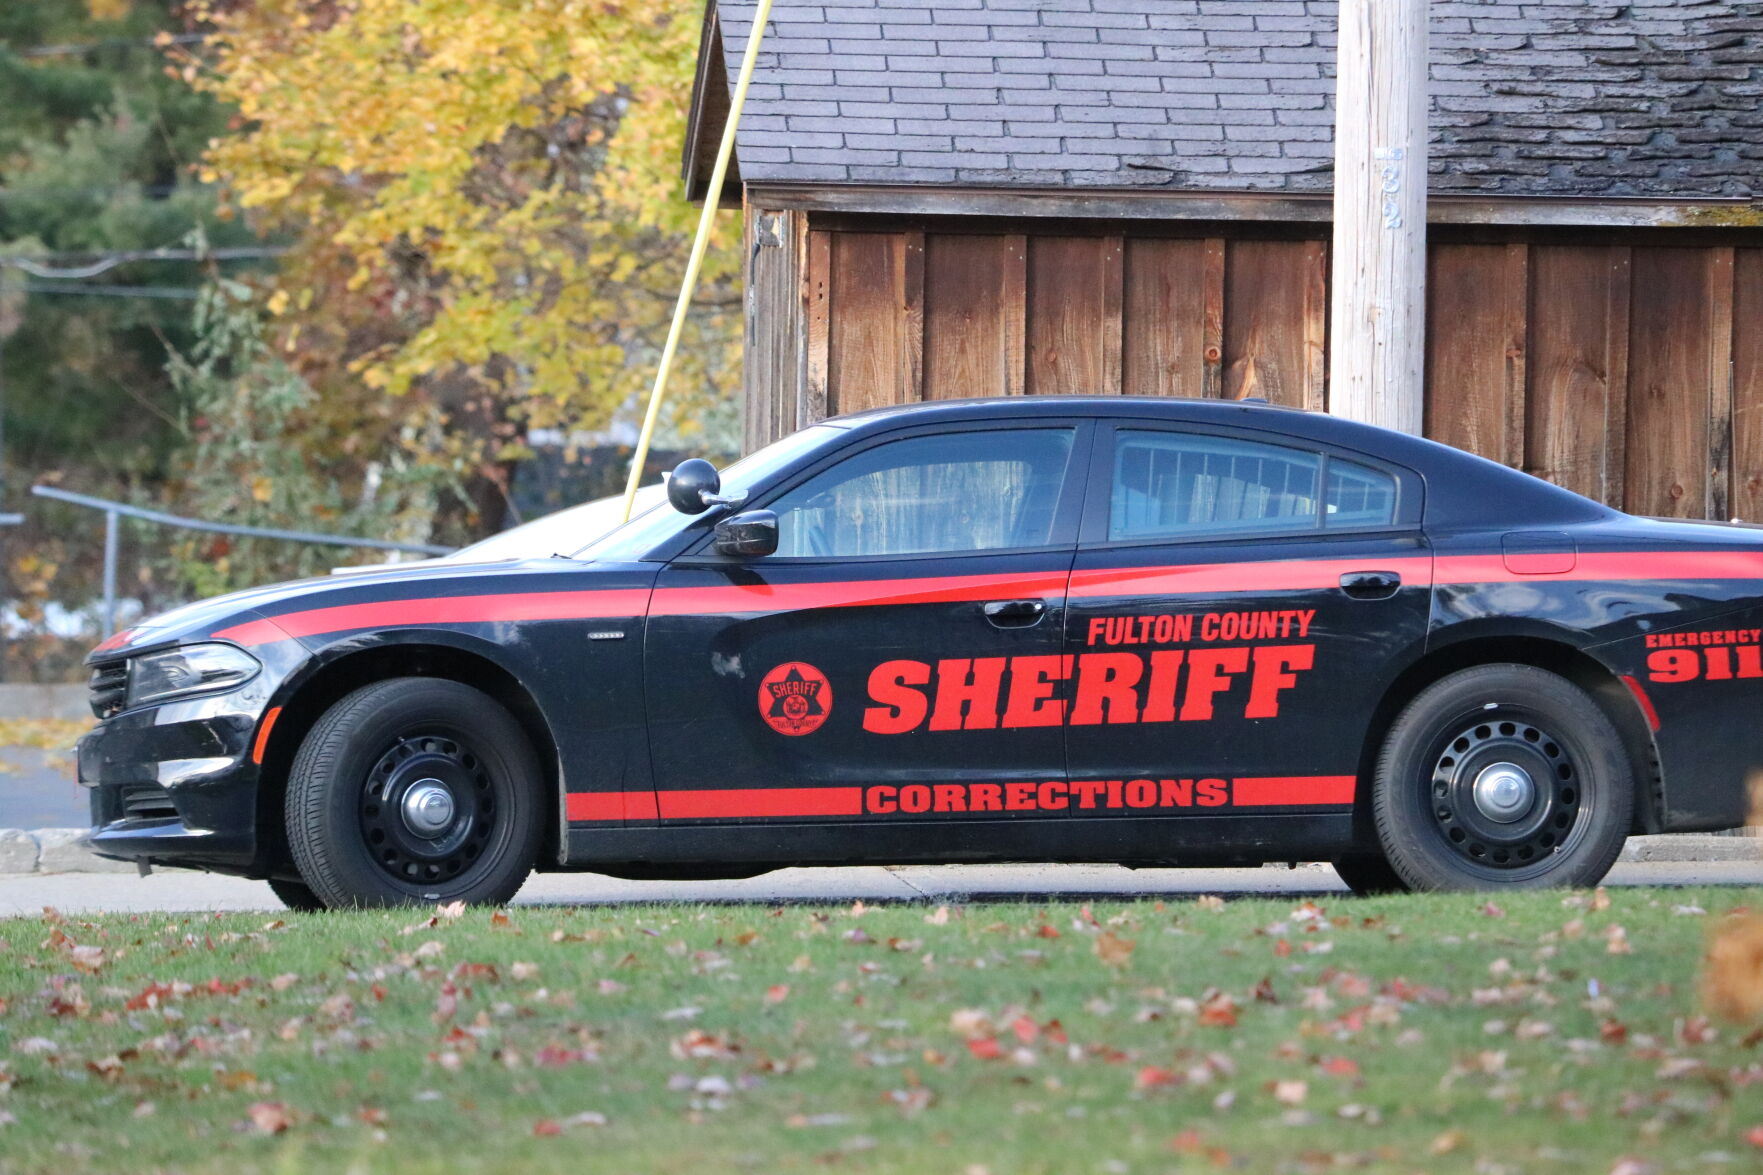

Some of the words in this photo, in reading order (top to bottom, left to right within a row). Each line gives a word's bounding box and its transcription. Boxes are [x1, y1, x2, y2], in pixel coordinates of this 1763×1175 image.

[1087, 614, 1192, 646] FULTON
[1200, 609, 1317, 642] COUNTY
[1645, 629, 1762, 648] EMERGENCY
[1646, 645, 1763, 683] 911
[772, 681, 818, 698] SHERIFF
[862, 644, 1316, 735] SHERIFF
[865, 778, 1229, 814] CORRECTIONS
